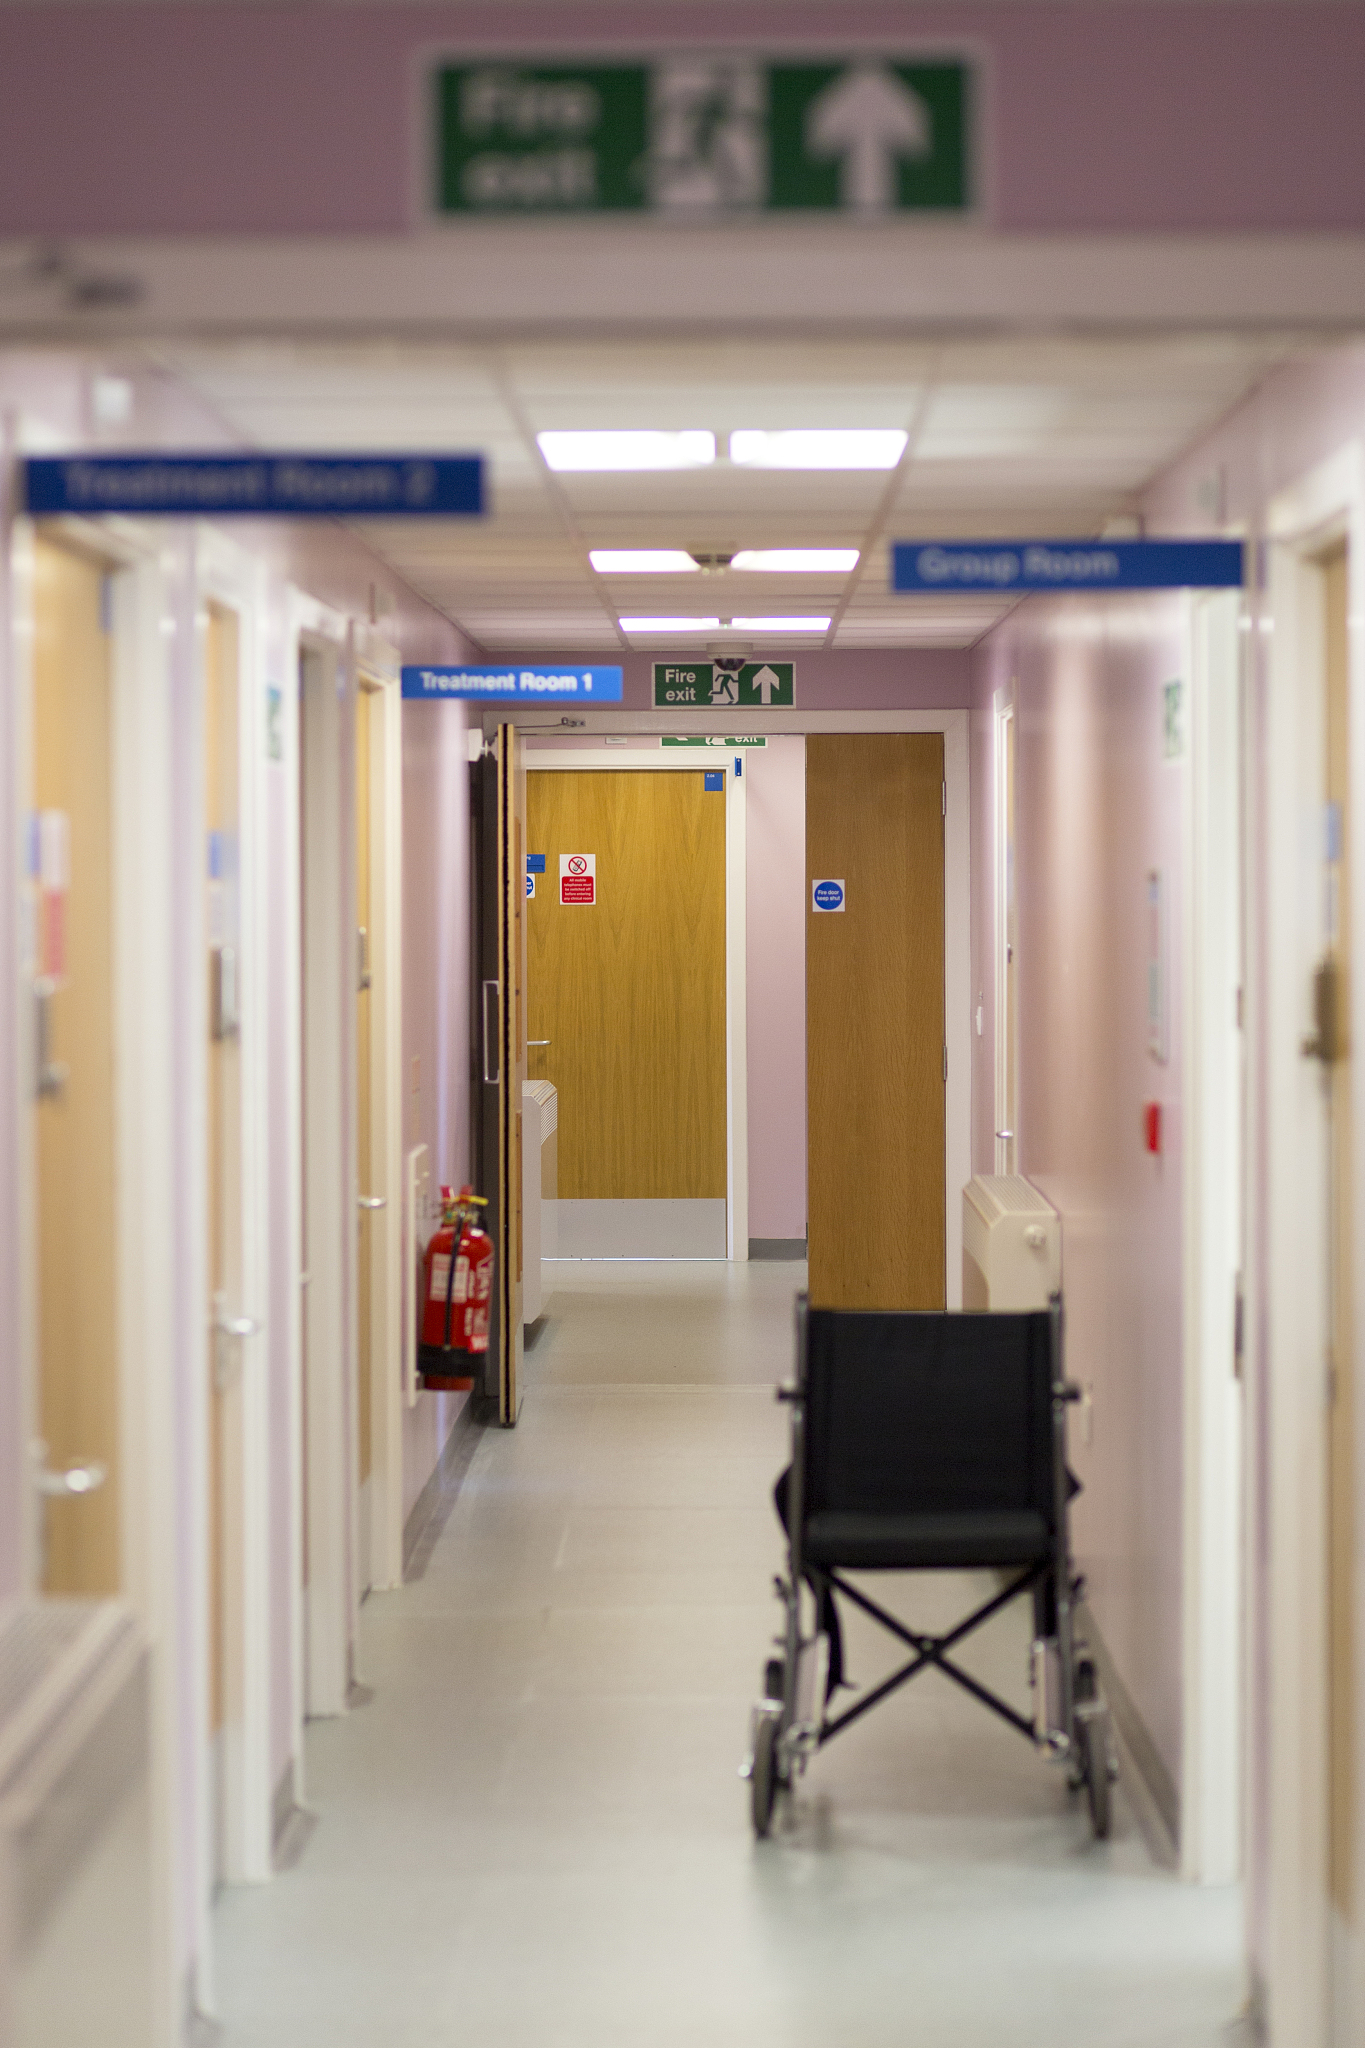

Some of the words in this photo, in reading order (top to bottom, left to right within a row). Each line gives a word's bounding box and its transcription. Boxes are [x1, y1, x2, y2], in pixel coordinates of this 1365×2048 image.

[464, 68, 597, 136] Fire
[464, 147, 596, 205] exit
[65, 461, 264, 498] Treatment
[274, 461, 398, 498] Room
[917, 547, 1020, 583] Group
[1024, 547, 1120, 580] Room
[420, 671, 516, 691] Treatment
[519, 672, 577, 692] Room
[582, 672, 593, 692] 1
[665, 669, 696, 683] Fire
[665, 687, 696, 701] exit
